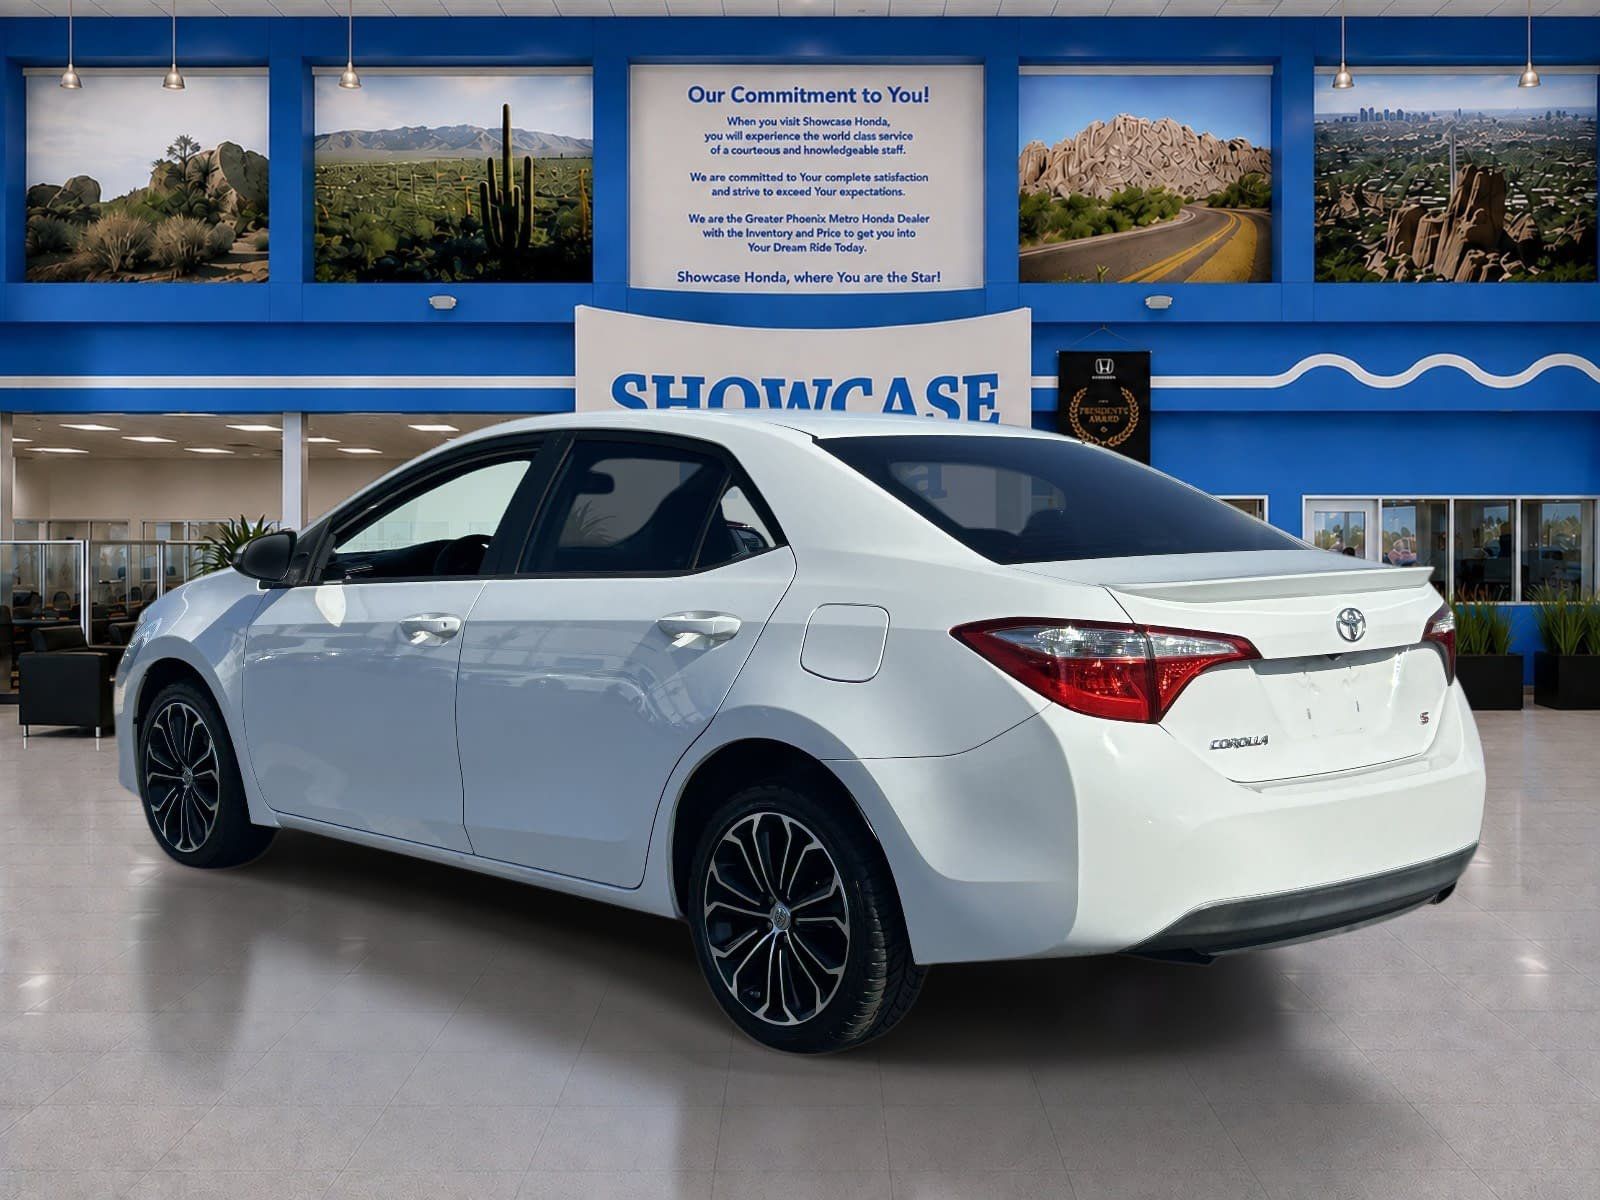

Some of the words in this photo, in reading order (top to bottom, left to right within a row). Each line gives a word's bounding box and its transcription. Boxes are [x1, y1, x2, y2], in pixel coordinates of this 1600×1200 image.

[688, 86, 726, 103] Our
[731, 86, 857, 103] Commitment
[862, 88, 883, 103] to
[887, 86, 930, 103] You!
[726, 115, 757, 127] When
[758, 118, 778, 129] you
[779, 116, 801, 127] visit
[802, 116, 853, 127] Showcase
[854, 116, 891, 128] Honda,
[704, 132, 724, 144] you
[725, 130, 743, 141] will
[745, 130, 801, 144] experience
[802, 130, 820, 141] the
[822, 130, 851, 142] world
[853, 130, 877, 142] class
[878, 130, 914, 142] service
[709, 144, 722, 155] of
[722, 147, 730, 156] a
[730, 146, 781, 156] courteous
[782, 144, 802, 155] and
[881, 143, 907, 155] staff.
[689, 171, 708, 183] We
[709, 174, 727, 182] are
[728, 171, 784, 183] committed
[785, 173, 798, 183] to
[799, 171, 823, 183] Your
[824, 171, 872, 185] complete
[873, 171, 929, 183] satisfaction
[711, 185, 731, 197] and
[732, 186, 761, 197] strive
[762, 187, 774, 197] to
[775, 186, 812, 197] exceed
[813, 186, 838, 197] Your
[839, 186, 906, 200] expectations.
[688, 213, 706, 225] We
[707, 215, 725, 224] are
[725, 213, 743, 224] the
[744, 213, 785, 224] Greater
[785, 213, 827, 224] Phoenix
[828, 213, 860, 224] Metro
[861, 213, 895, 224] Honda
[897, 213, 930, 224] Dealer
[702, 227, 725, 238] with
[726, 227, 744, 239] the
[745, 227, 794, 241] Inventory
[794, 227, 815, 239] and
[816, 227, 842, 239] Price
[843, 229, 855, 239] to
[856, 229, 875, 241] get
[876, 230, 895, 241] you
[896, 227, 917, 239] into
[747, 242, 772, 253] Your
[773, 242, 808, 253] Dream
[809, 242, 833, 253] Ride
[833, 242, 867, 255] Today.
[677, 271, 740, 283] Showcase
[745, 271, 790, 285] Honda,
[794, 271, 833, 283] where
[837, 272, 860, 283] You
[864, 275, 883, 283] are
[887, 271, 907, 283] the
[911, 271, 940, 283] Star!
[611, 373, 999, 424] SHOWCASE
[1419, 711, 1430, 725] S
[1209, 735, 1269, 750] COROLLA
